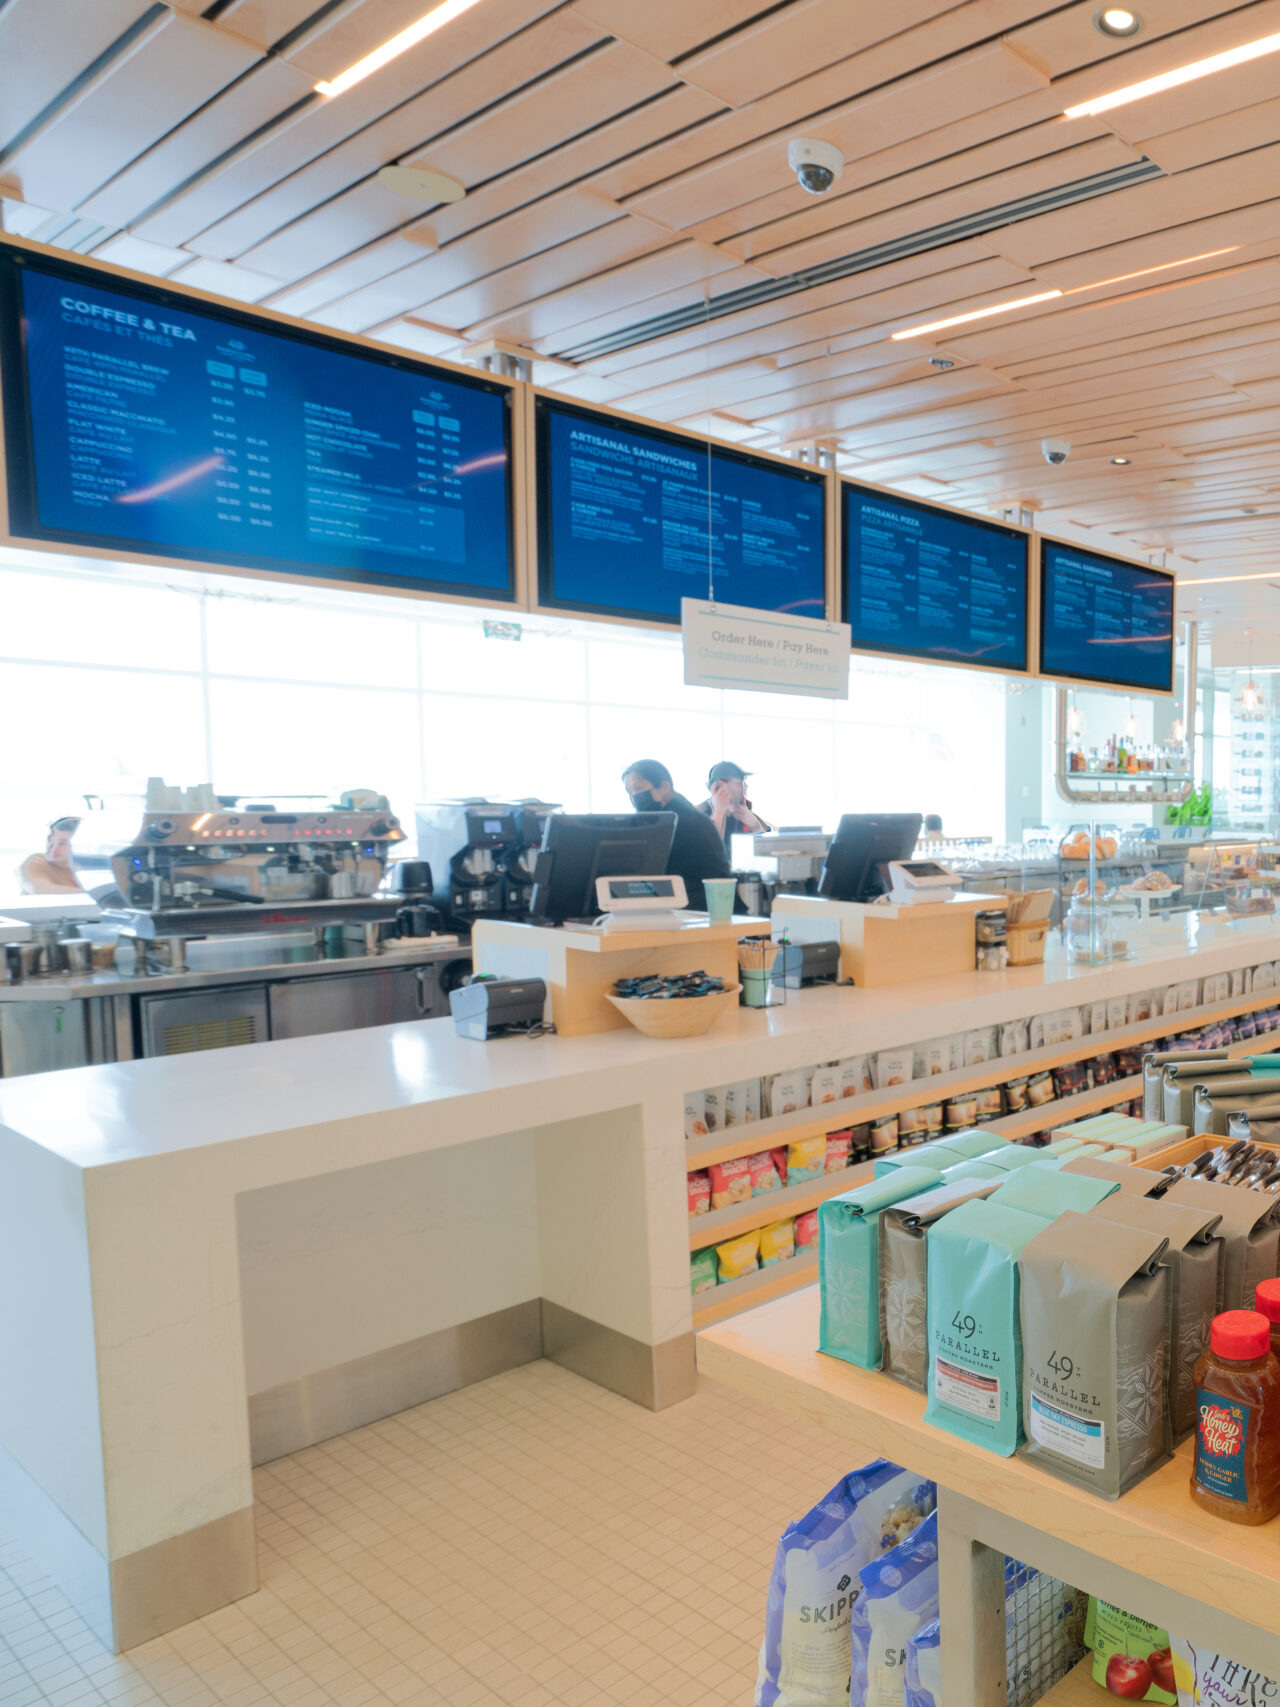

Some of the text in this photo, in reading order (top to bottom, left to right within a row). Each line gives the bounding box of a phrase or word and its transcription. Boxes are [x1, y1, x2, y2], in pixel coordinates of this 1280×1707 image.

[60, 296, 197, 342] COFFEE & TEA
[115, 325, 133, 337] ET
[570, 430, 698, 471] ARTISANAL SANDWICHES
[712, 630, 830, 656] Order Here Pay Here
[698, 647, 840, 673] Commander Ici Payer Ici
[952, 1310, 976, 1338] 49
[936, 1330, 1000, 1362] PARALLEL
[960, 1355, 994, 1370] ROASTERS
[1047, 1350, 1073, 1380] 49
[1029, 1367, 1101, 1406] PARALLEL
[1056, 1396, 1093, 1414] ROASTERS
[1061, 1416, 1088, 1433] ESPRESSO
[1200, 1405, 1239, 1438] Honey
[1205, 1427, 1237, 1454] Heat
[1209, 1470, 1233, 1483] GINGER
[1217, 1467, 1240, 1478] GARLIC
[1101, 1609, 1142, 1634] MIXED FRUITS
[1203, 1671, 1247, 1706] your
